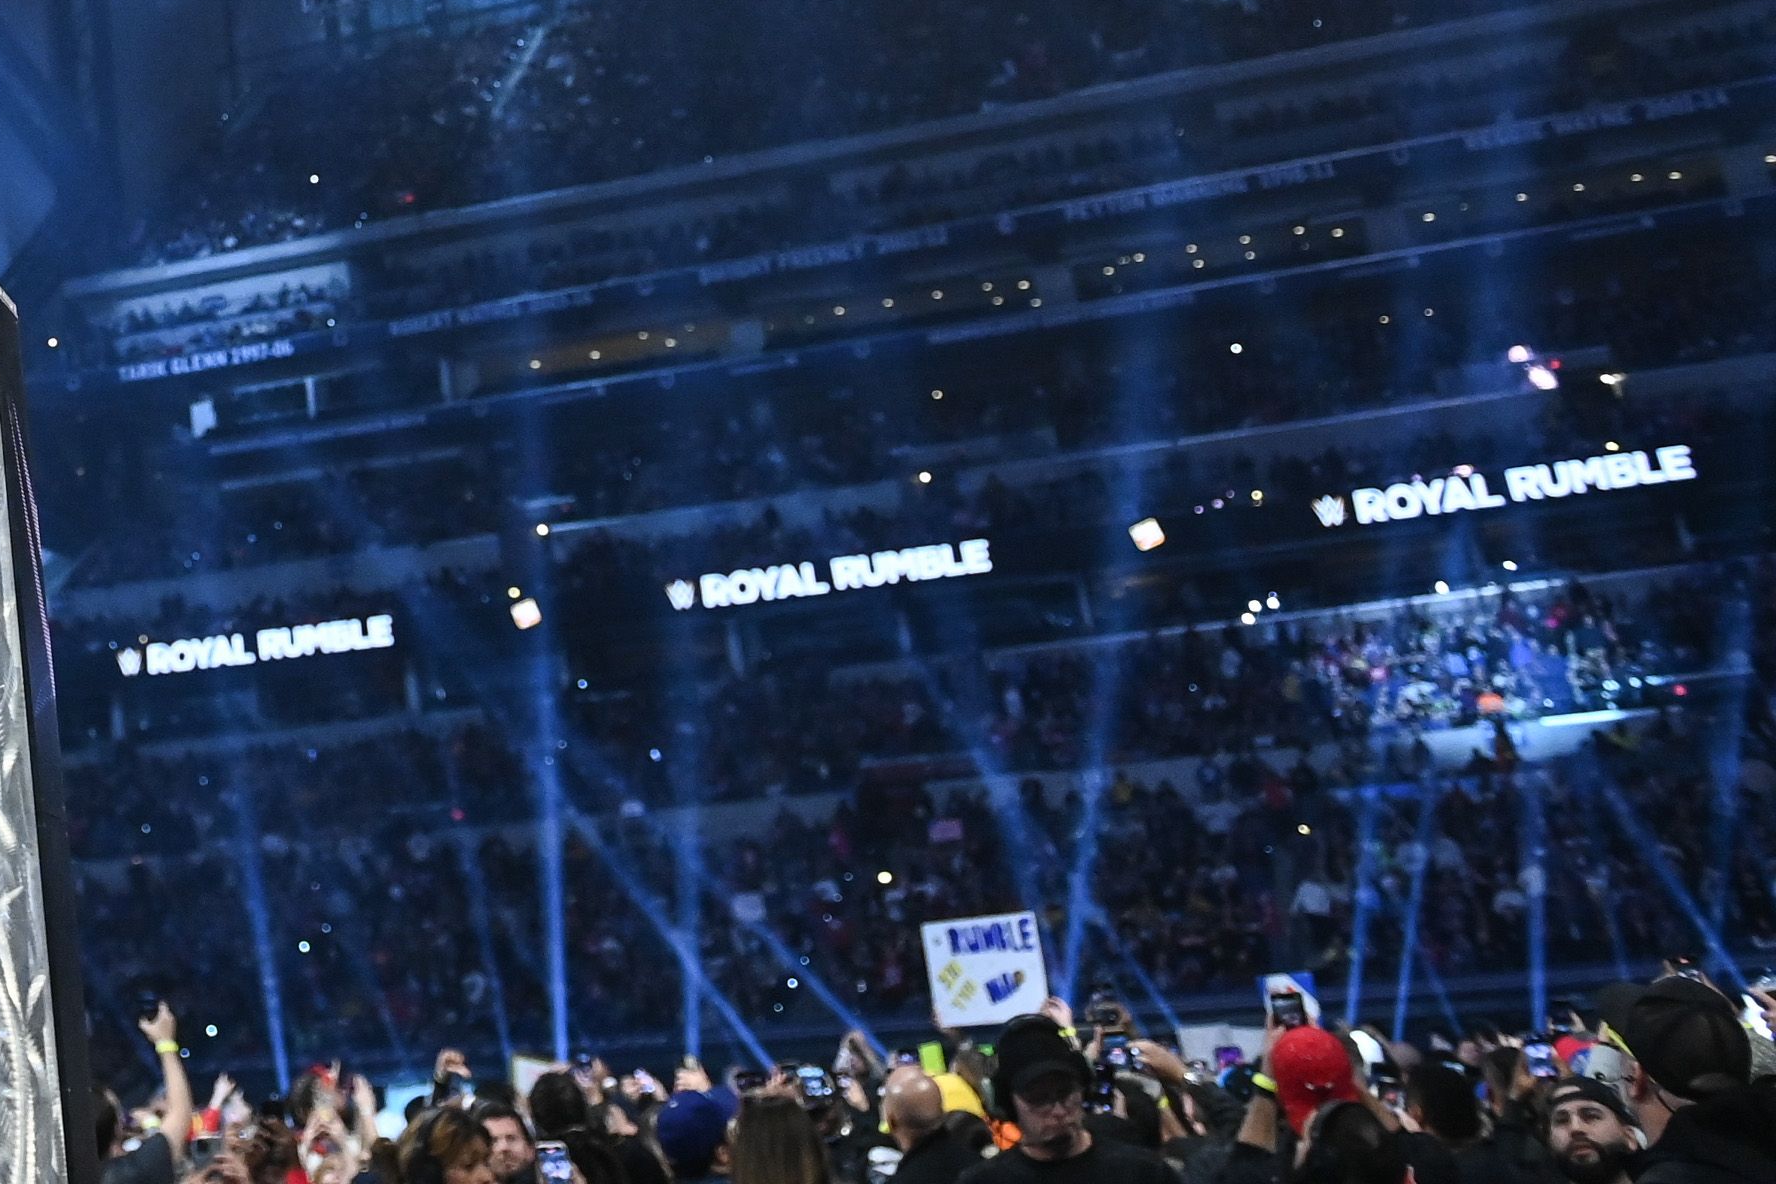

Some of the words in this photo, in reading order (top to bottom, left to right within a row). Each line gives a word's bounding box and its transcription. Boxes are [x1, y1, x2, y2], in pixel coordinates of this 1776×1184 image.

[1352, 472, 1505, 525] ROYAL
[1504, 444, 1697, 502] RUMBLE
[700, 561, 831, 609] ROYAL
[829, 538, 993, 591] RUMBLE
[146, 633, 257, 676] ROYAL
[256, 614, 395, 662] RUMBLE
